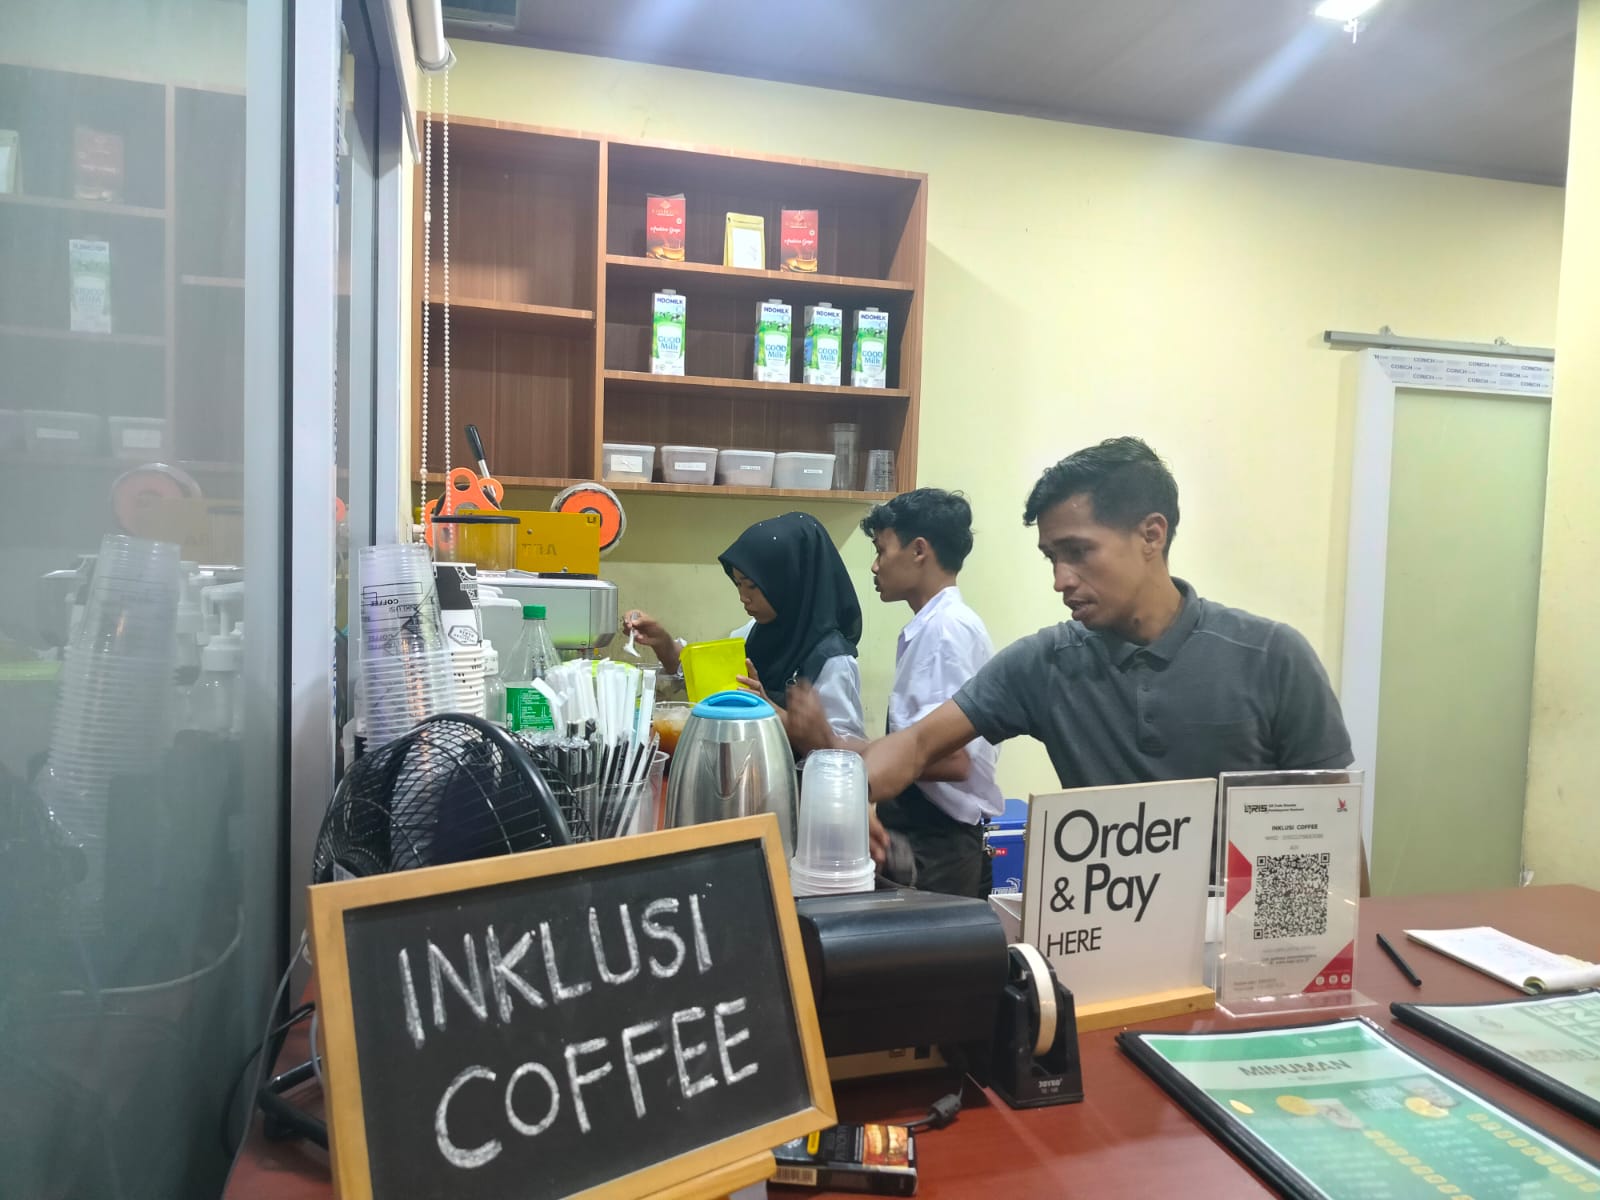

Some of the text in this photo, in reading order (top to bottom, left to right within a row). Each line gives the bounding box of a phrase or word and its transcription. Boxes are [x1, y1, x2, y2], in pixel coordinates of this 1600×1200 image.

[658, 336, 681, 344] GOOD
[660, 343, 679, 351] Milk
[765, 344, 787, 352] GOOD
[818, 347, 838, 355] GOOD
[767, 350, 784, 359] Milk
[820, 353, 836, 361] Milk
[862, 350, 883, 358] GOOD
[864, 357, 880, 365] Milk
[1054, 801, 1191, 863] Order
[1050, 863, 1161, 923] & Pay
[1047, 926, 1102, 957] HERE
[397, 893, 714, 1050] INKLUSI
[1238, 1059, 1353, 1076] MINUMAN
[434, 996, 761, 1170] COFFEE
